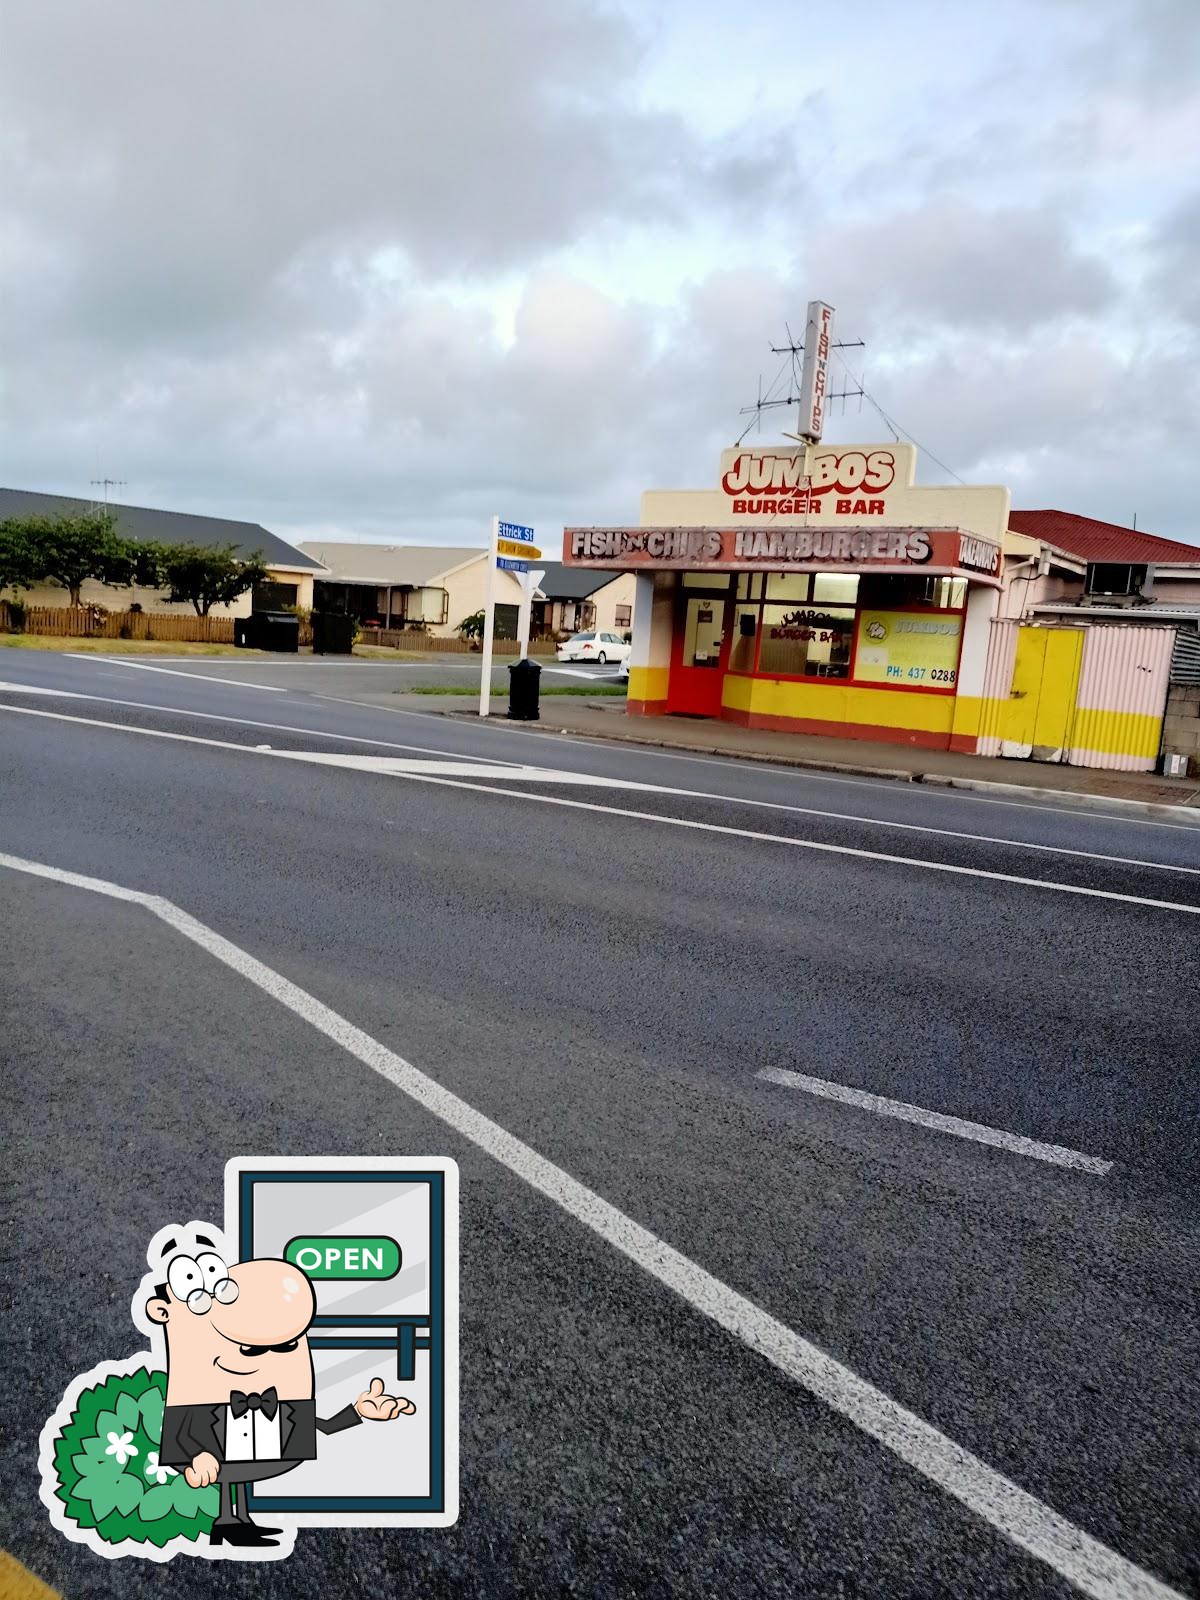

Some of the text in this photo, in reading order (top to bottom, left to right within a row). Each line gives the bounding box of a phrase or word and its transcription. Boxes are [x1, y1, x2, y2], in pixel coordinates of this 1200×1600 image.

[817, 309, 831, 360] FISH
[811, 369, 826, 432] CHIPS
[722, 451, 895, 496] JUMBOS
[732, 499, 885, 514] BURGER BAR
[498, 523, 534, 541] Ettrick St
[571, 531, 622, 558] FISH
[648, 530, 722, 559] CHIPS
[733, 530, 932, 563] HAMBURGERS
[887, 665, 956, 683] PH: 437 0288
